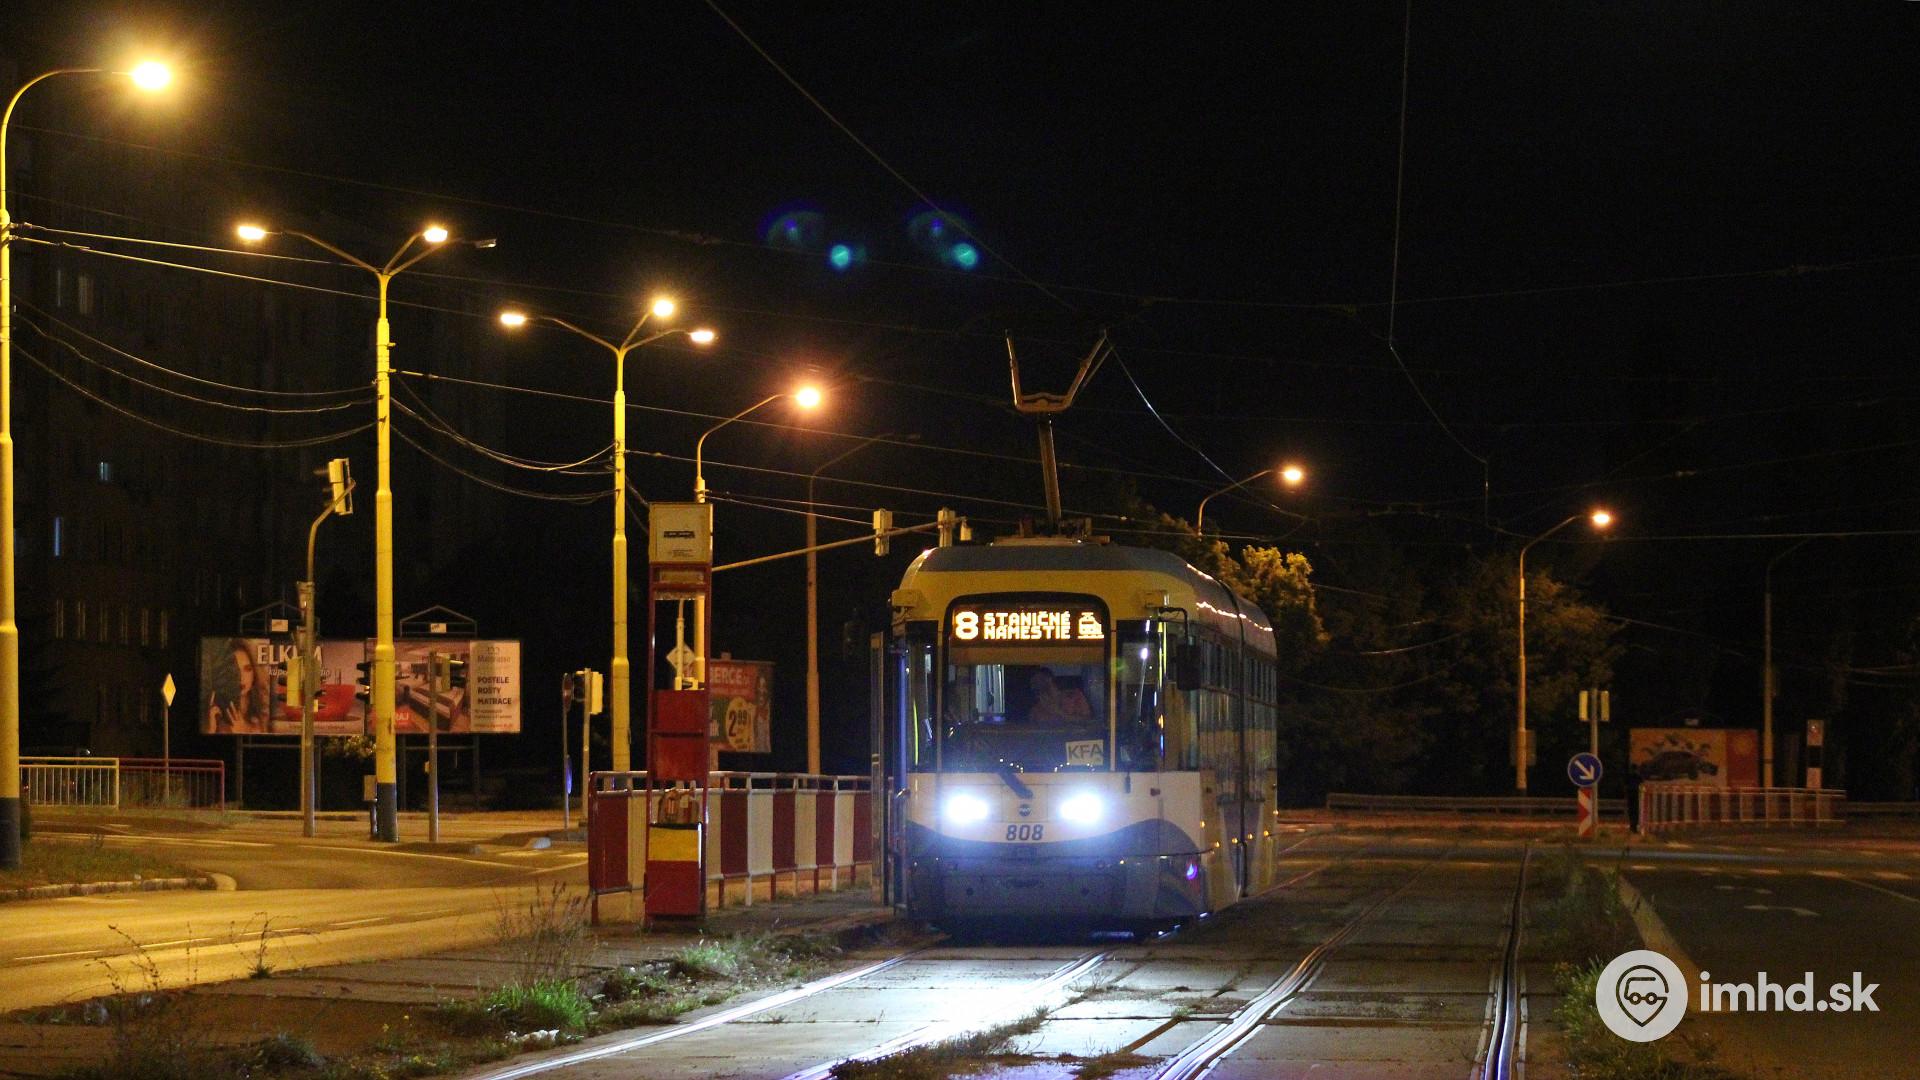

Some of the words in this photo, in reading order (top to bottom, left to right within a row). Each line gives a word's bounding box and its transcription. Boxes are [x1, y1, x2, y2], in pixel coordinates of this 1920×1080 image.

[955, 611, 979, 640] 8
[984, 611, 1071, 626] STANIČNÉ
[1068, 744, 1103, 760] KFA
[1006, 824, 1044, 841] 808
